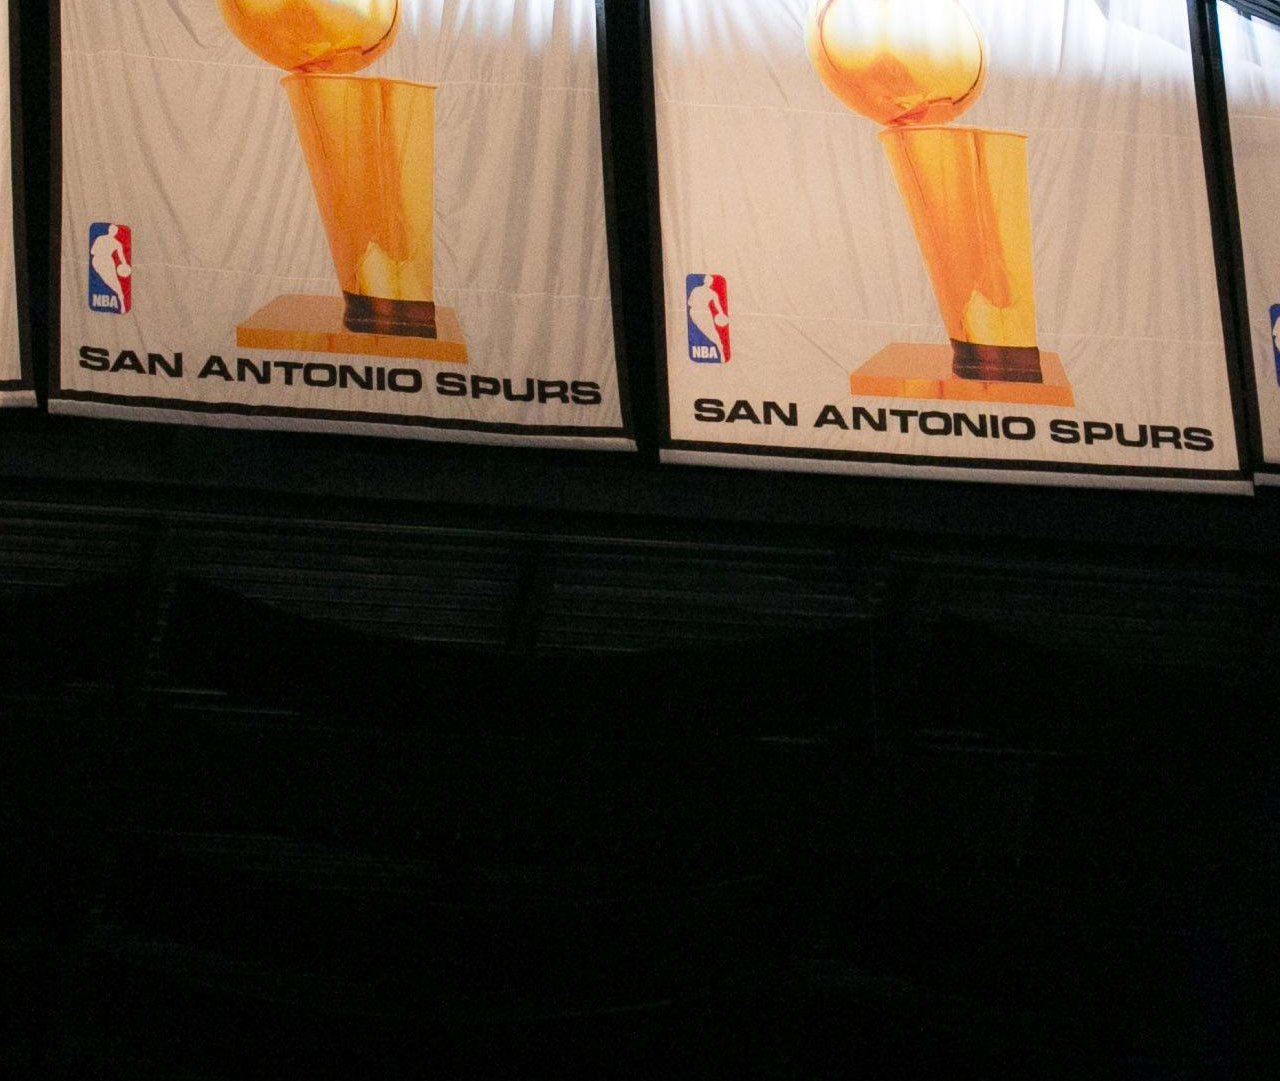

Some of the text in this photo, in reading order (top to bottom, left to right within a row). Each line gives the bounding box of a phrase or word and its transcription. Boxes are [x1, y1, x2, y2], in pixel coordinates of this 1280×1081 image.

[92, 294, 119, 309] NBA
[691, 345, 718, 360] NBA
[79, 346, 601, 406] SAN ANTONIO SPURS
[693, 398, 1214, 453] SAN ANTONIO SPURS
